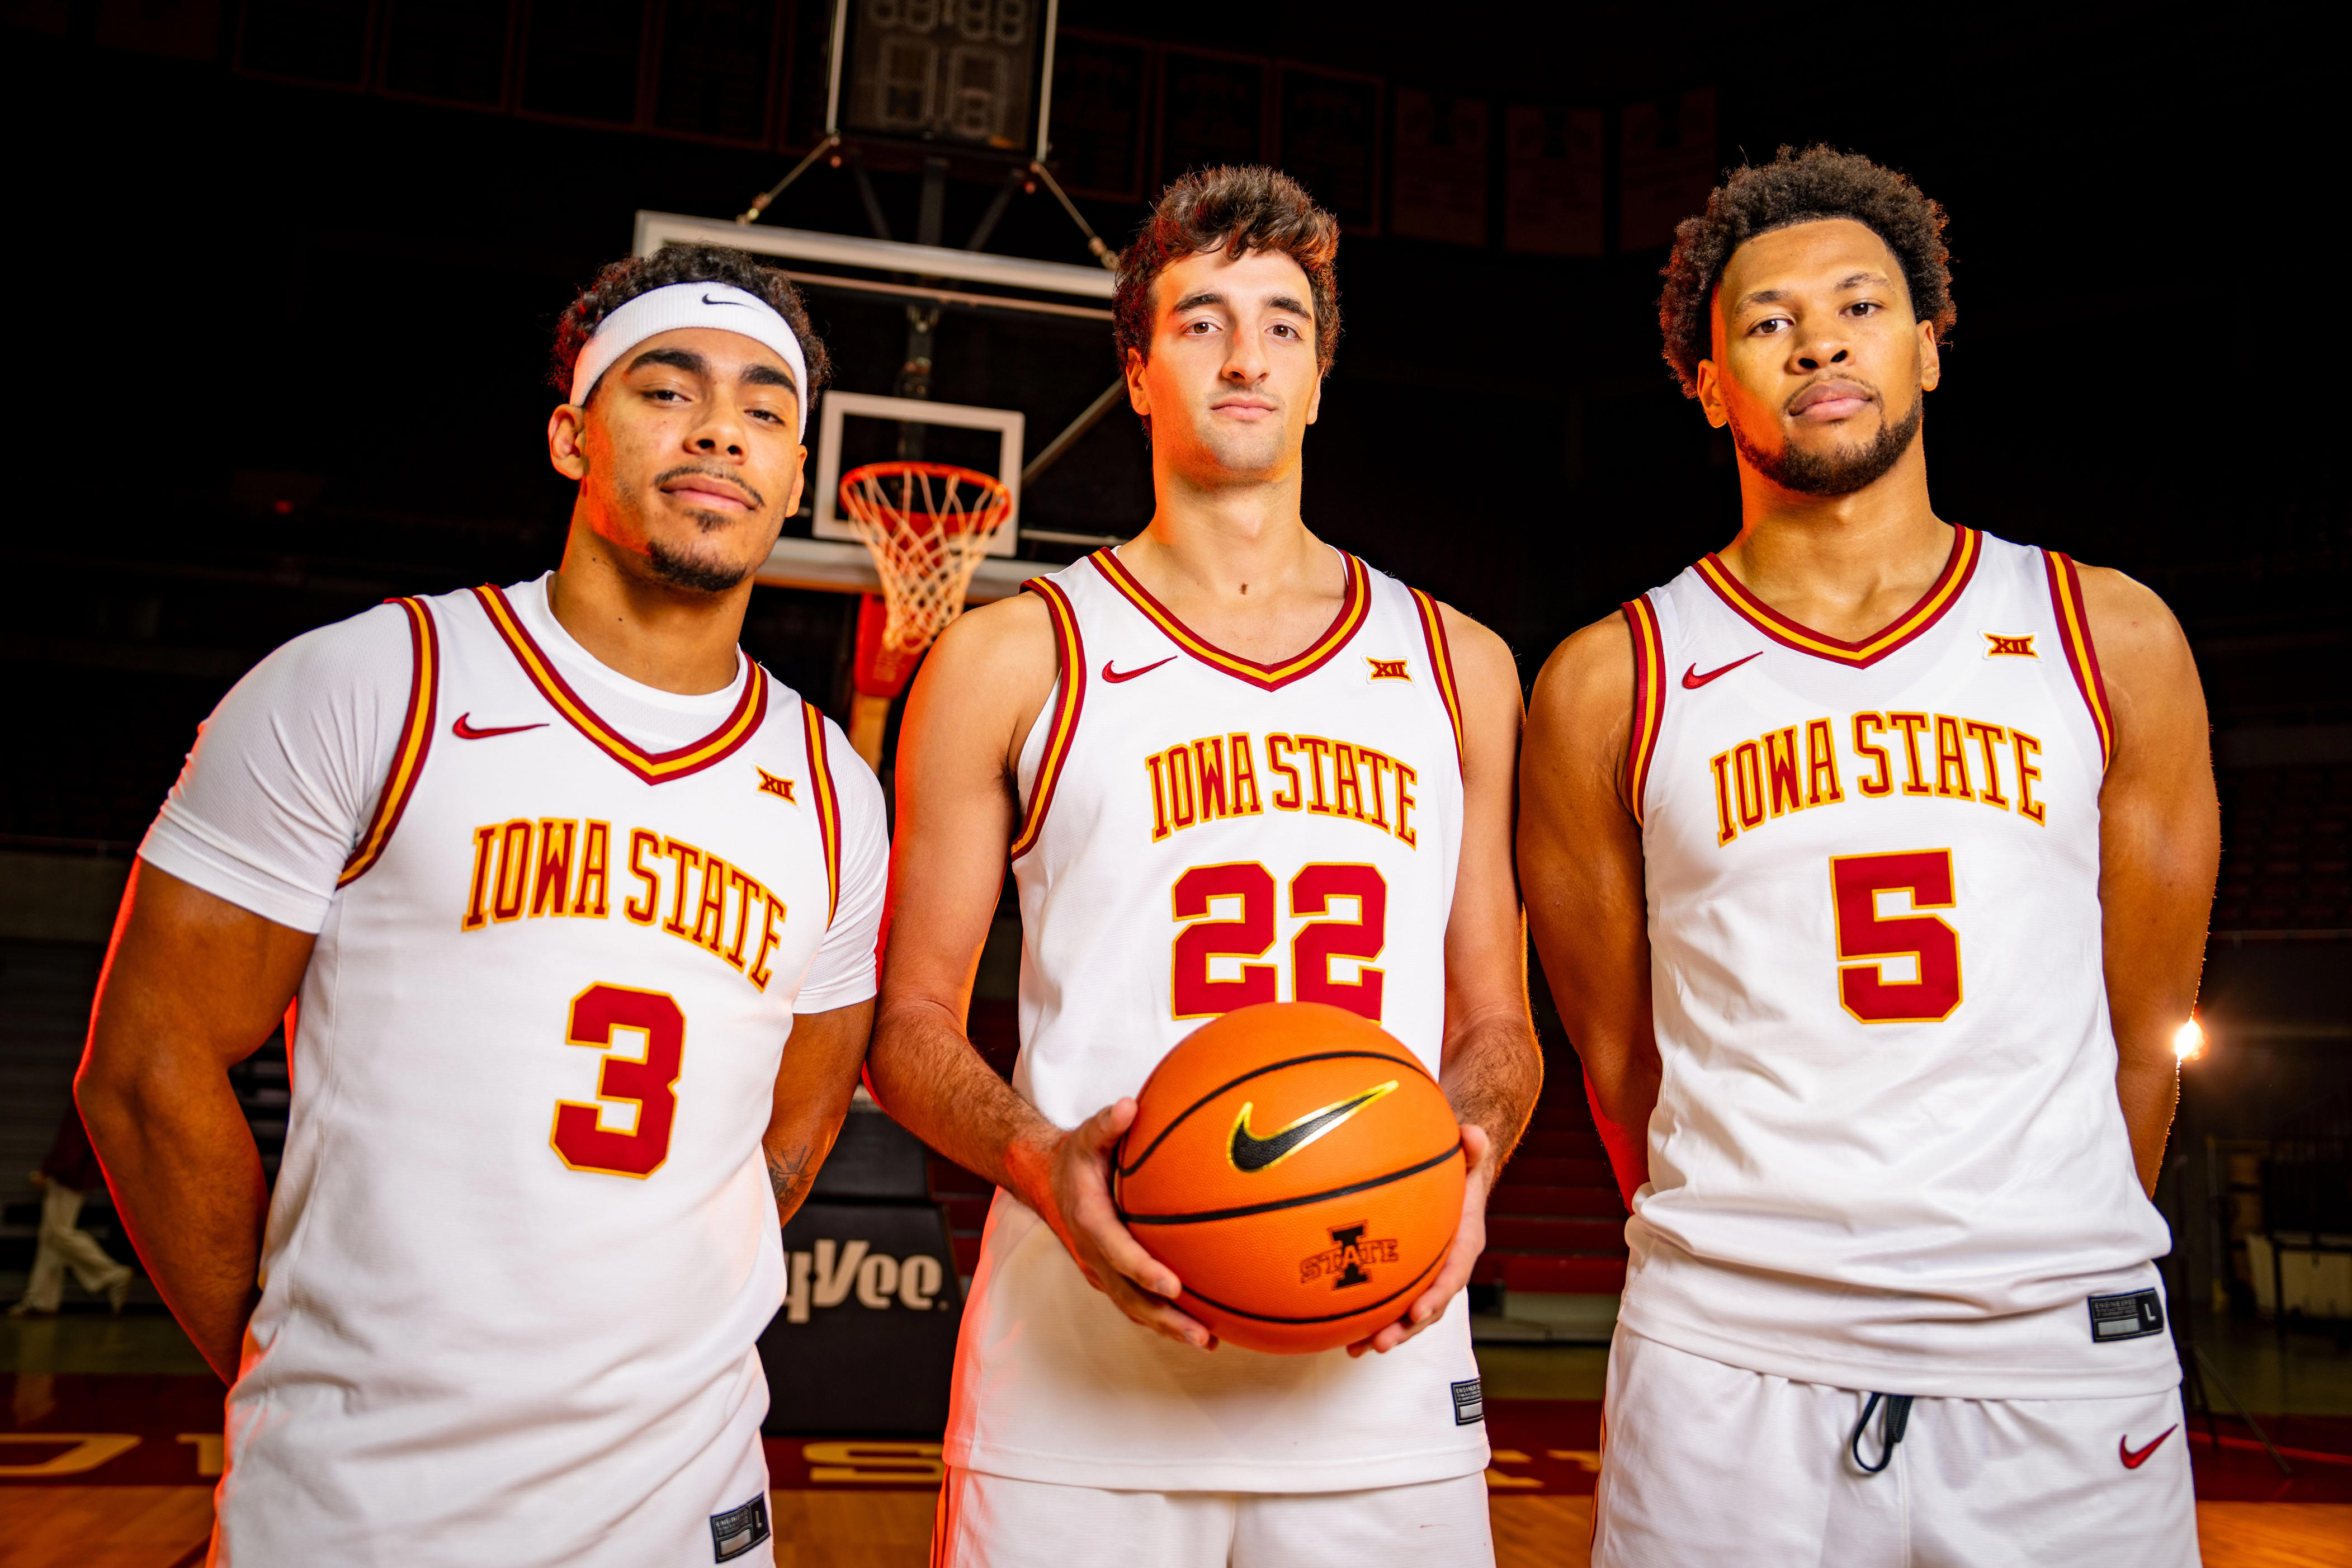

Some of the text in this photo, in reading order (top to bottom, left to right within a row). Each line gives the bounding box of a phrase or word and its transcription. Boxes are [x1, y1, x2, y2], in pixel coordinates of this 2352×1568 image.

[1366, 658, 1412, 682] XII
[1985, 634, 2038, 658] XII
[756, 766, 796, 805] XII
[1145, 733, 1417, 851] IOWA STATE
[1710, 711, 2046, 847] IOWA STATE
[461, 818, 787, 993] IOWA STATE
[1171, 861, 1387, 1025] 22
[1830, 848, 1963, 1024] 5
[549, 981, 686, 1180] 3
[784, 1238, 943, 1324] yVee
[1300, 1239, 1399, 1283] STATE
[2144, 1303, 2156, 1322] L
[755, 1510, 763, 1529] L
